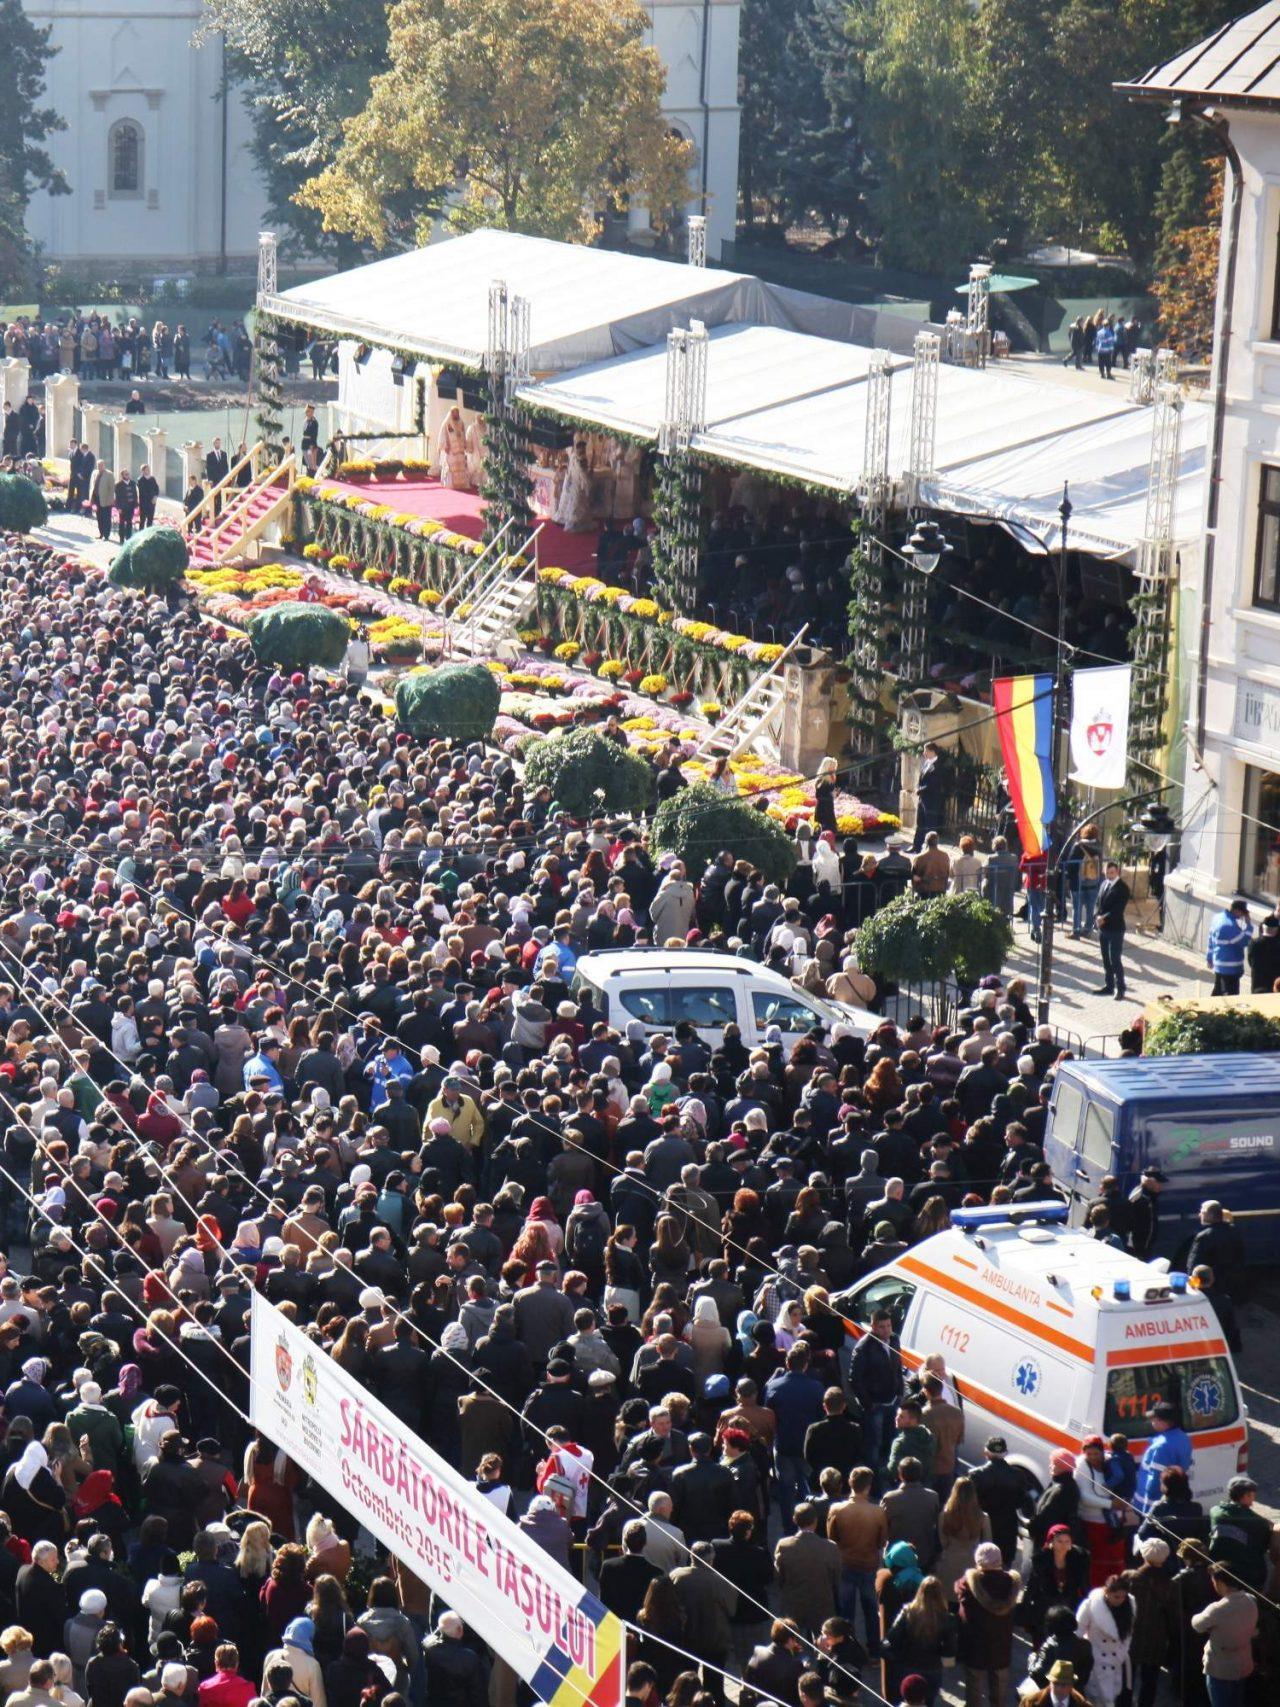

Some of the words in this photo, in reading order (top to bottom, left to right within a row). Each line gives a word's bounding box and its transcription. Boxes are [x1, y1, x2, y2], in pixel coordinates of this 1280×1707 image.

[1229, 1135, 1273, 1149] SOUND
[981, 1268, 1041, 1308] AMBULANTA
[946, 1327, 970, 1354] 112
[1124, 1315, 1209, 1340] AMBULANTA
[341, 1458, 413, 1549] Octombrie
[416, 1527, 452, 1583] 2015
[340, 1397, 488, 1578] SĂRBĂTORILE
[495, 1537, 596, 1680] IAȘULUI
